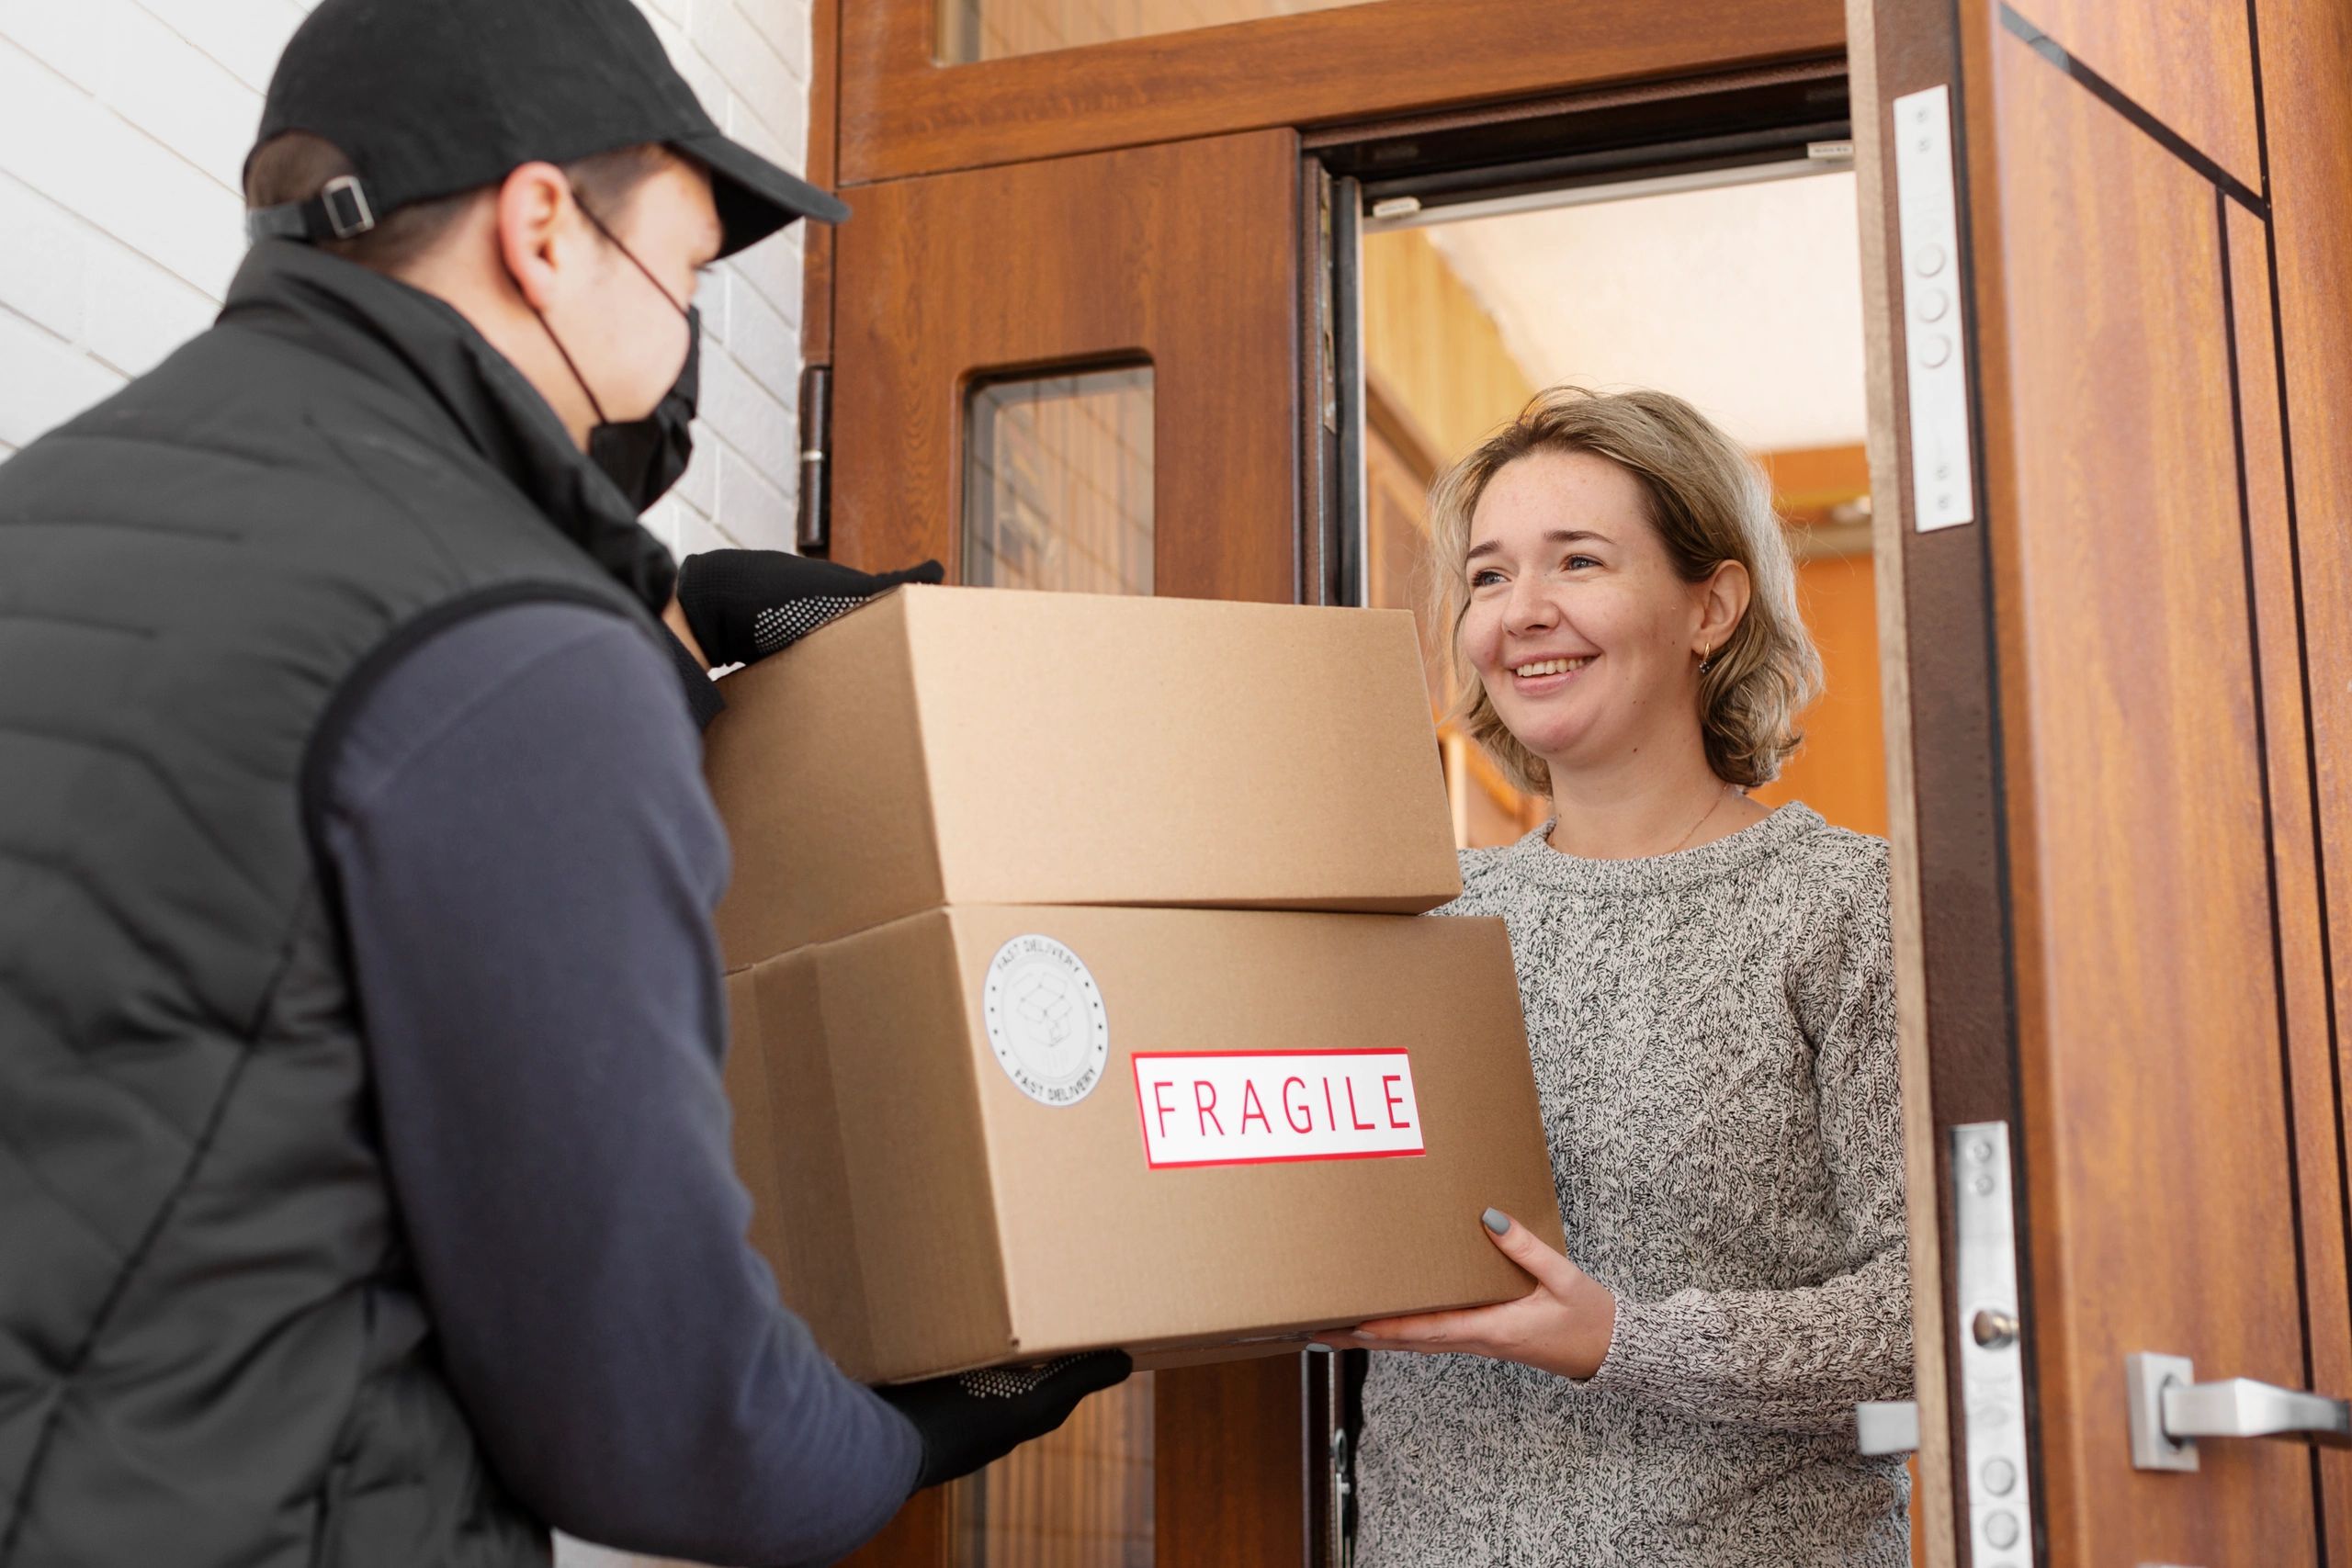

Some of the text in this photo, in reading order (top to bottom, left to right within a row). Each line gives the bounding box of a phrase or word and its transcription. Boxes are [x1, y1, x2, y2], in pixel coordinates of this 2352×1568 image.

[1014, 1066, 1096, 1101] FAST DELIVERY
[1154, 1076, 1410, 1138] FRAGILE
